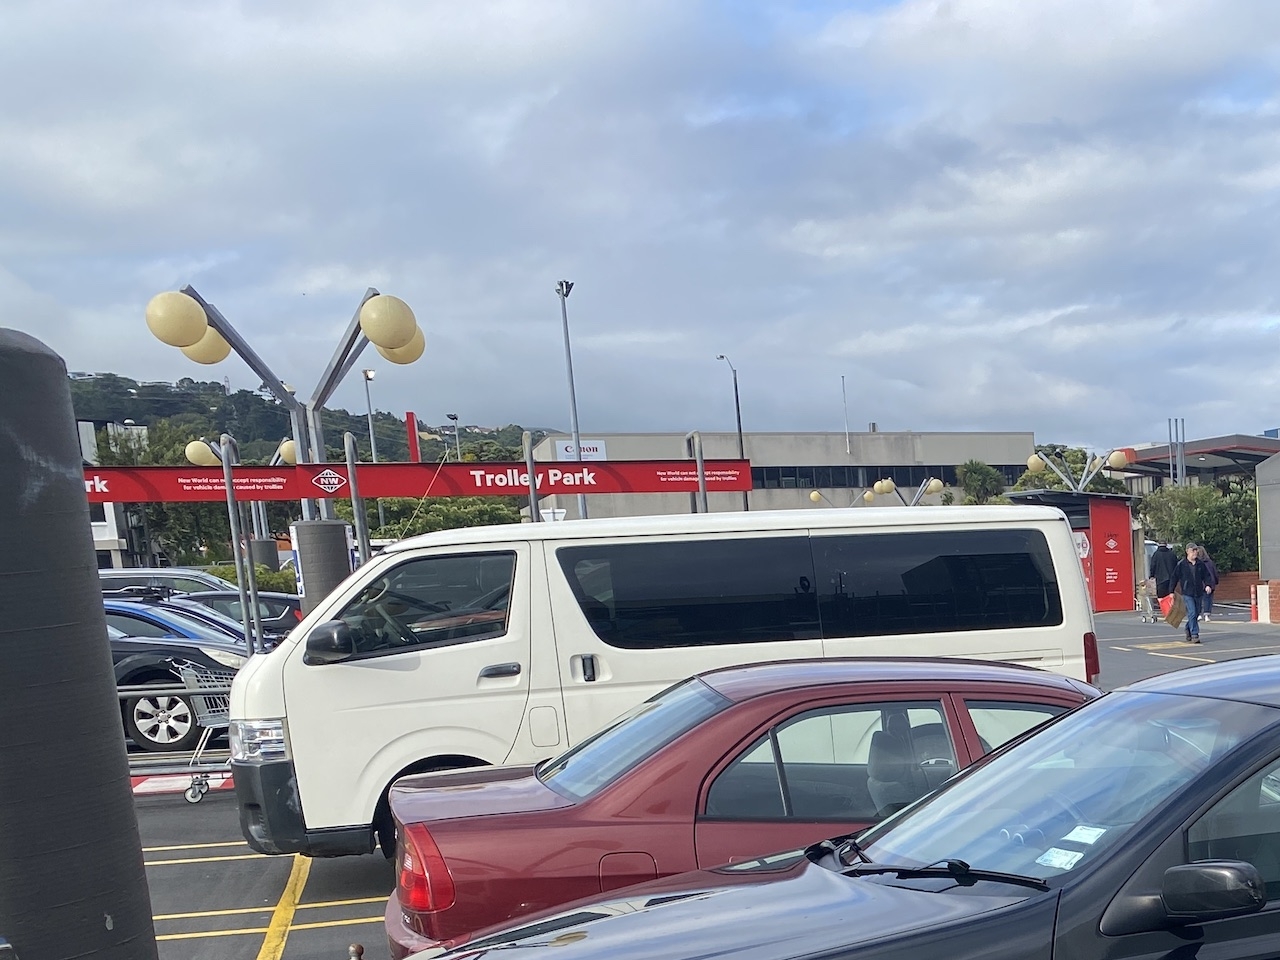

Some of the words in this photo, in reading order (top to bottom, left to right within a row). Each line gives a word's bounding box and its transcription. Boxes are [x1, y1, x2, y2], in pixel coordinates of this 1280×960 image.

[564, 445, 599, 453] Cnon
[470, 468, 543, 490] Trolley
[548, 468, 597, 486] Park
